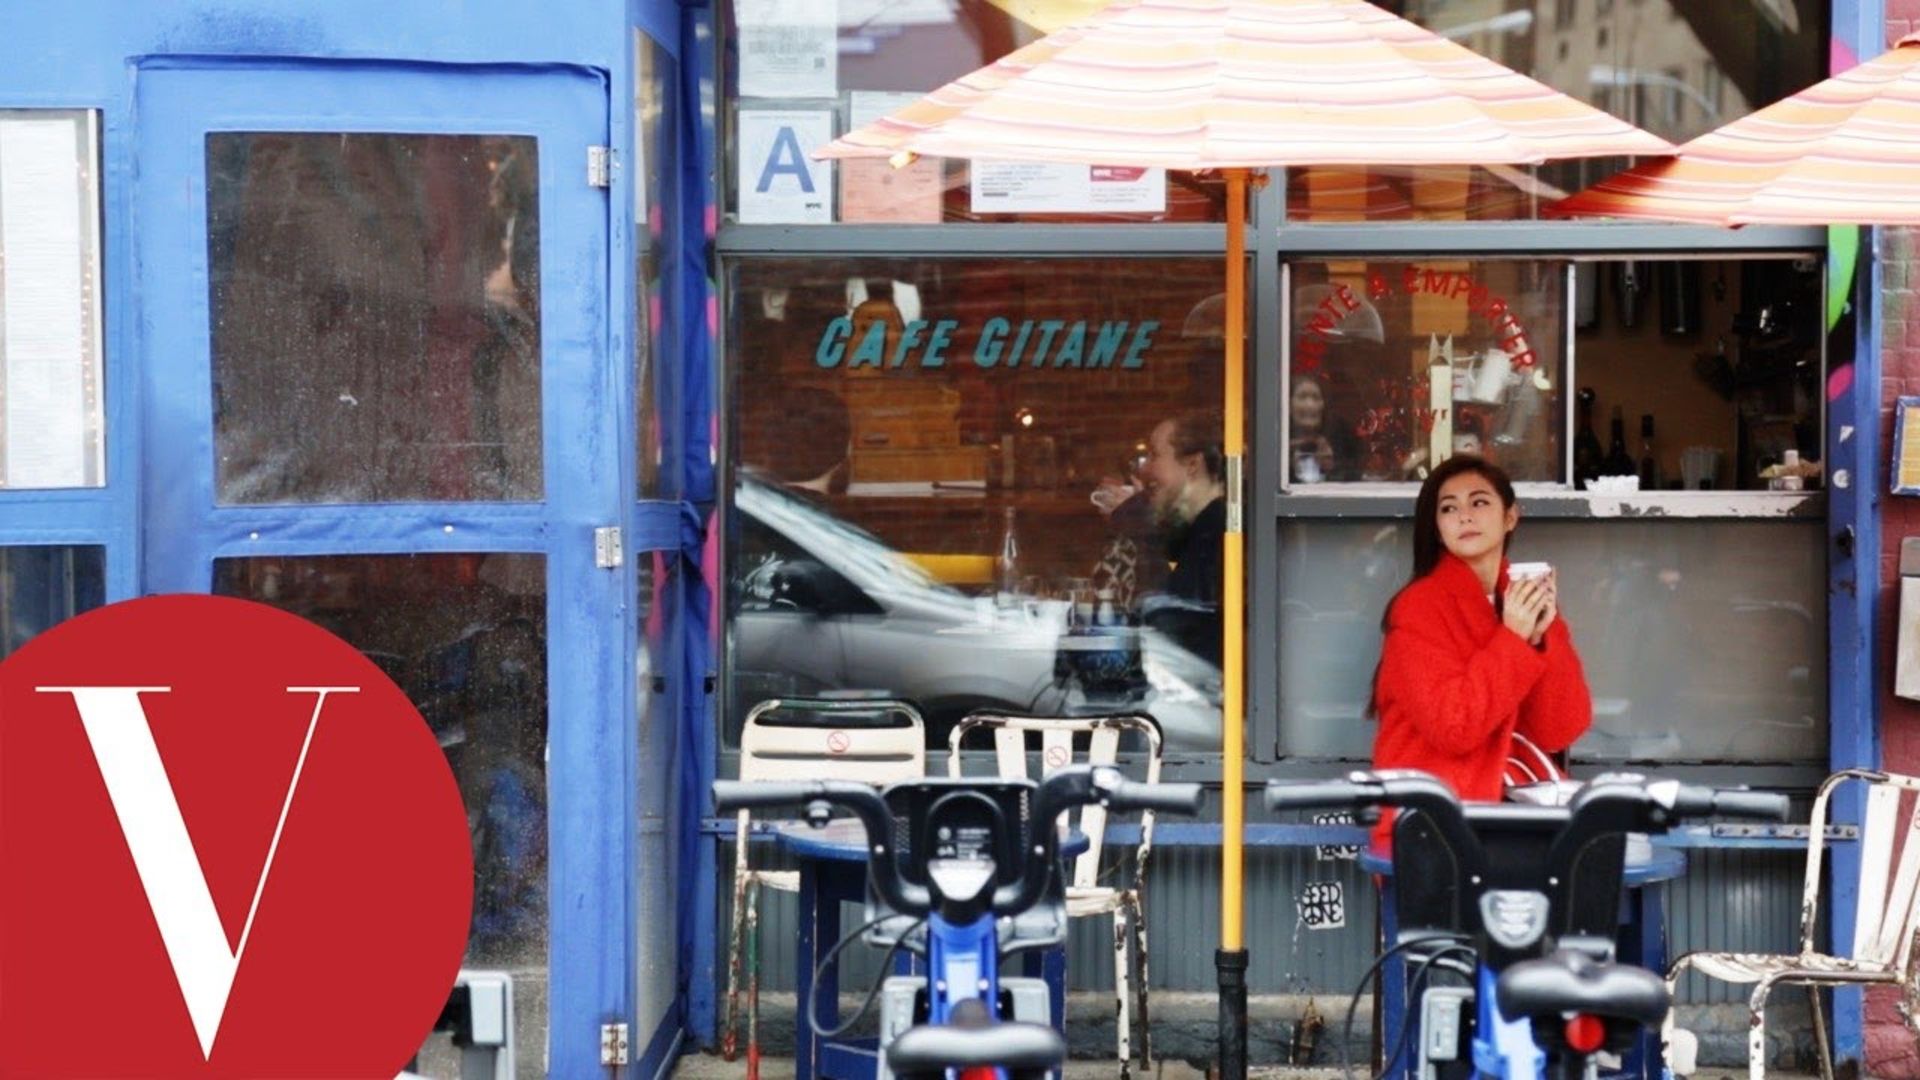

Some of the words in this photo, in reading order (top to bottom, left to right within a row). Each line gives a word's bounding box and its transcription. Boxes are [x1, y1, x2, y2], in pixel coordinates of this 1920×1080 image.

[756, 126, 816, 193] A
[816, 316, 958, 369] CAFE
[974, 316, 1160, 369] GITANE
